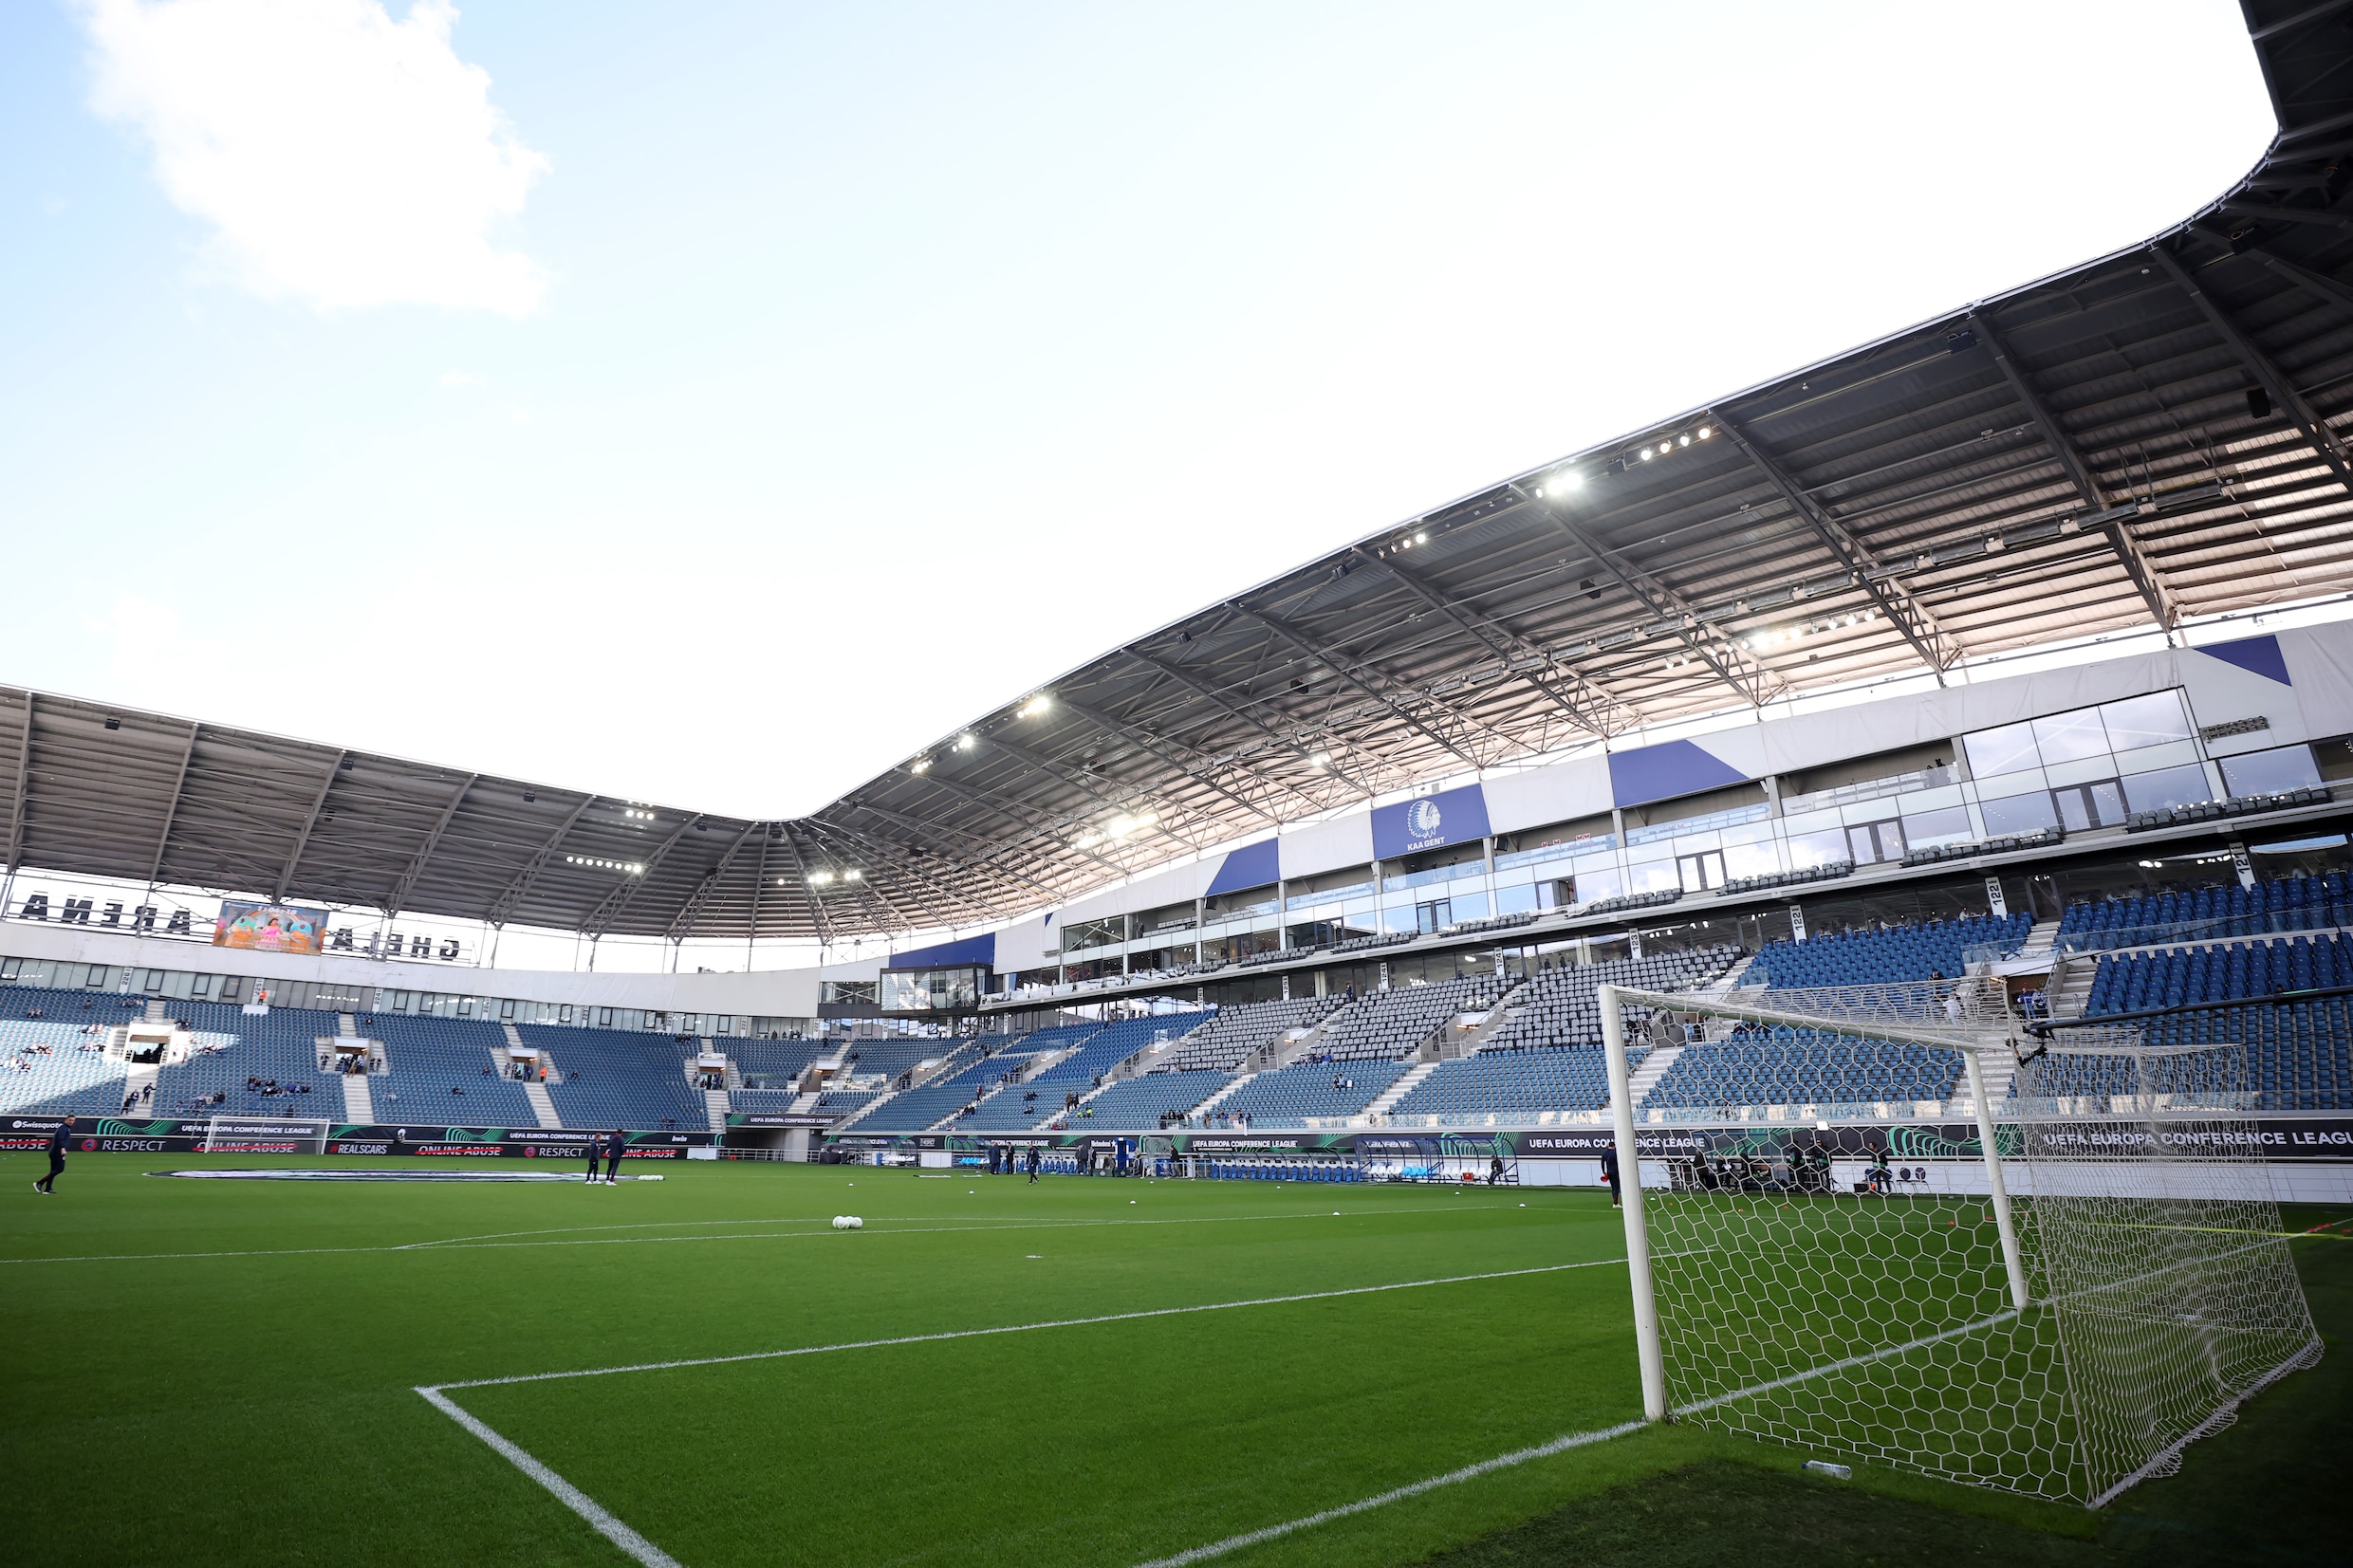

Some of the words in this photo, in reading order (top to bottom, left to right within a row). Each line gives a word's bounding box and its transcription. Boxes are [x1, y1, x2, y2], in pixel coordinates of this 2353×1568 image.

[1424, 837, 1445, 848] GENT
[2232, 852, 2251, 875] 121
[1990, 885, 2003, 906] 122
[1793, 912, 1803, 932] 122
[1631, 934, 1640, 951] 123
[121, 971, 131, 986] 226
[203, 1125, 232, 1134] EROPA
[233, 1126, 283, 1134] CONFERENCE
[284, 1127, 313, 1135] LEAGUE
[1529, 1138, 1554, 1149] UEFA
[1556, 1138, 1591, 1149] EUROPA
[1663, 1138, 1705, 1148] LEAGUE
[2046, 1134, 2088, 1146] UEFA
[2090, 1134, 2157, 1146] EUROPA
[2160, 1133, 2287, 1146] CONFERENCE
[102, 1140, 166, 1152] RESPECT
[196, 1141, 250, 1153] ONLINE
[250, 1143, 295, 1153] ABUSE
[330, 1144, 388, 1155] #REALSCARS
[417, 1145, 463, 1155] ONLINE
[463, 1147, 502, 1156] ABUSE
[538, 1148, 584, 1157] RESPECT
[644, 1150, 676, 1158] ABUSE
